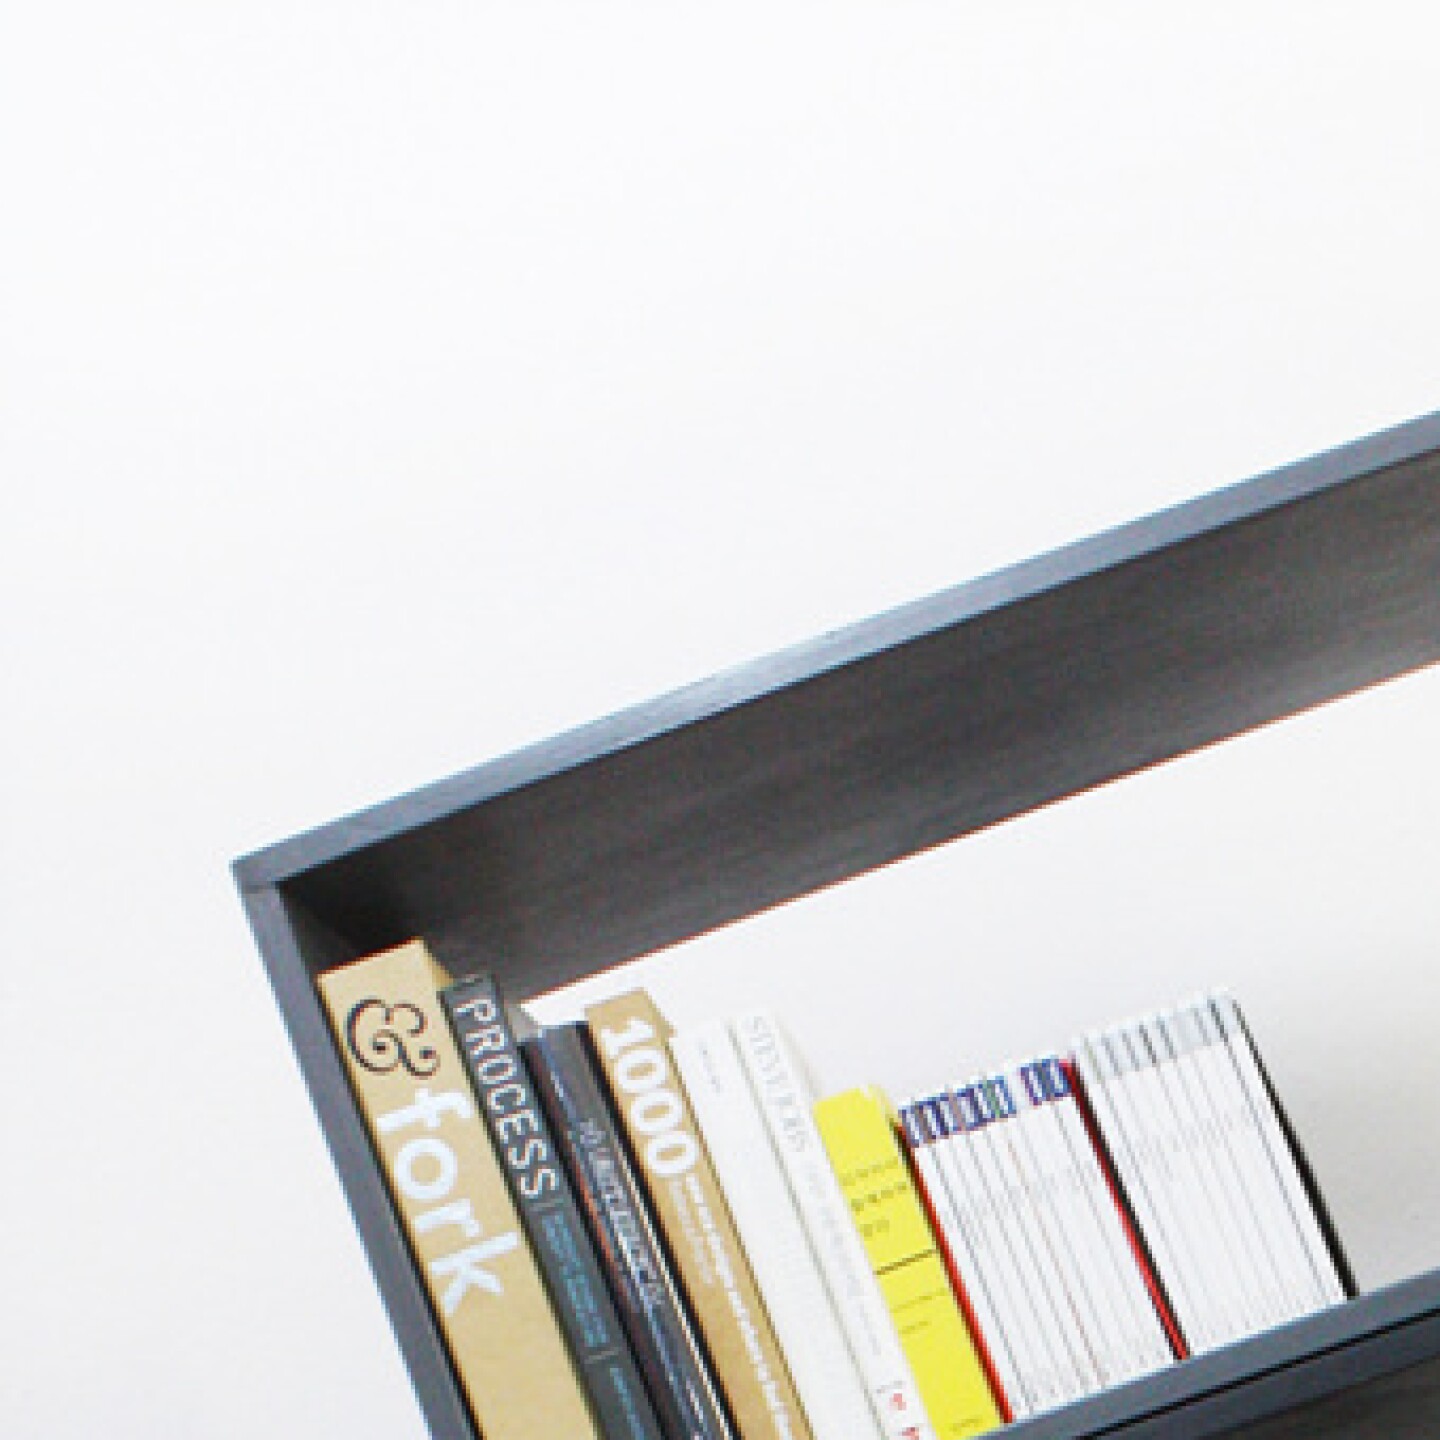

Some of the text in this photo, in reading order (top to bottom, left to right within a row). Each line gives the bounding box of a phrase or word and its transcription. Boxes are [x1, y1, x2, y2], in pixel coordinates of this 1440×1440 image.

[455, 1000, 560, 1199] PROCESS
[602, 1019, 699, 1179] 1000
[374, 1086, 519, 1315] fork
